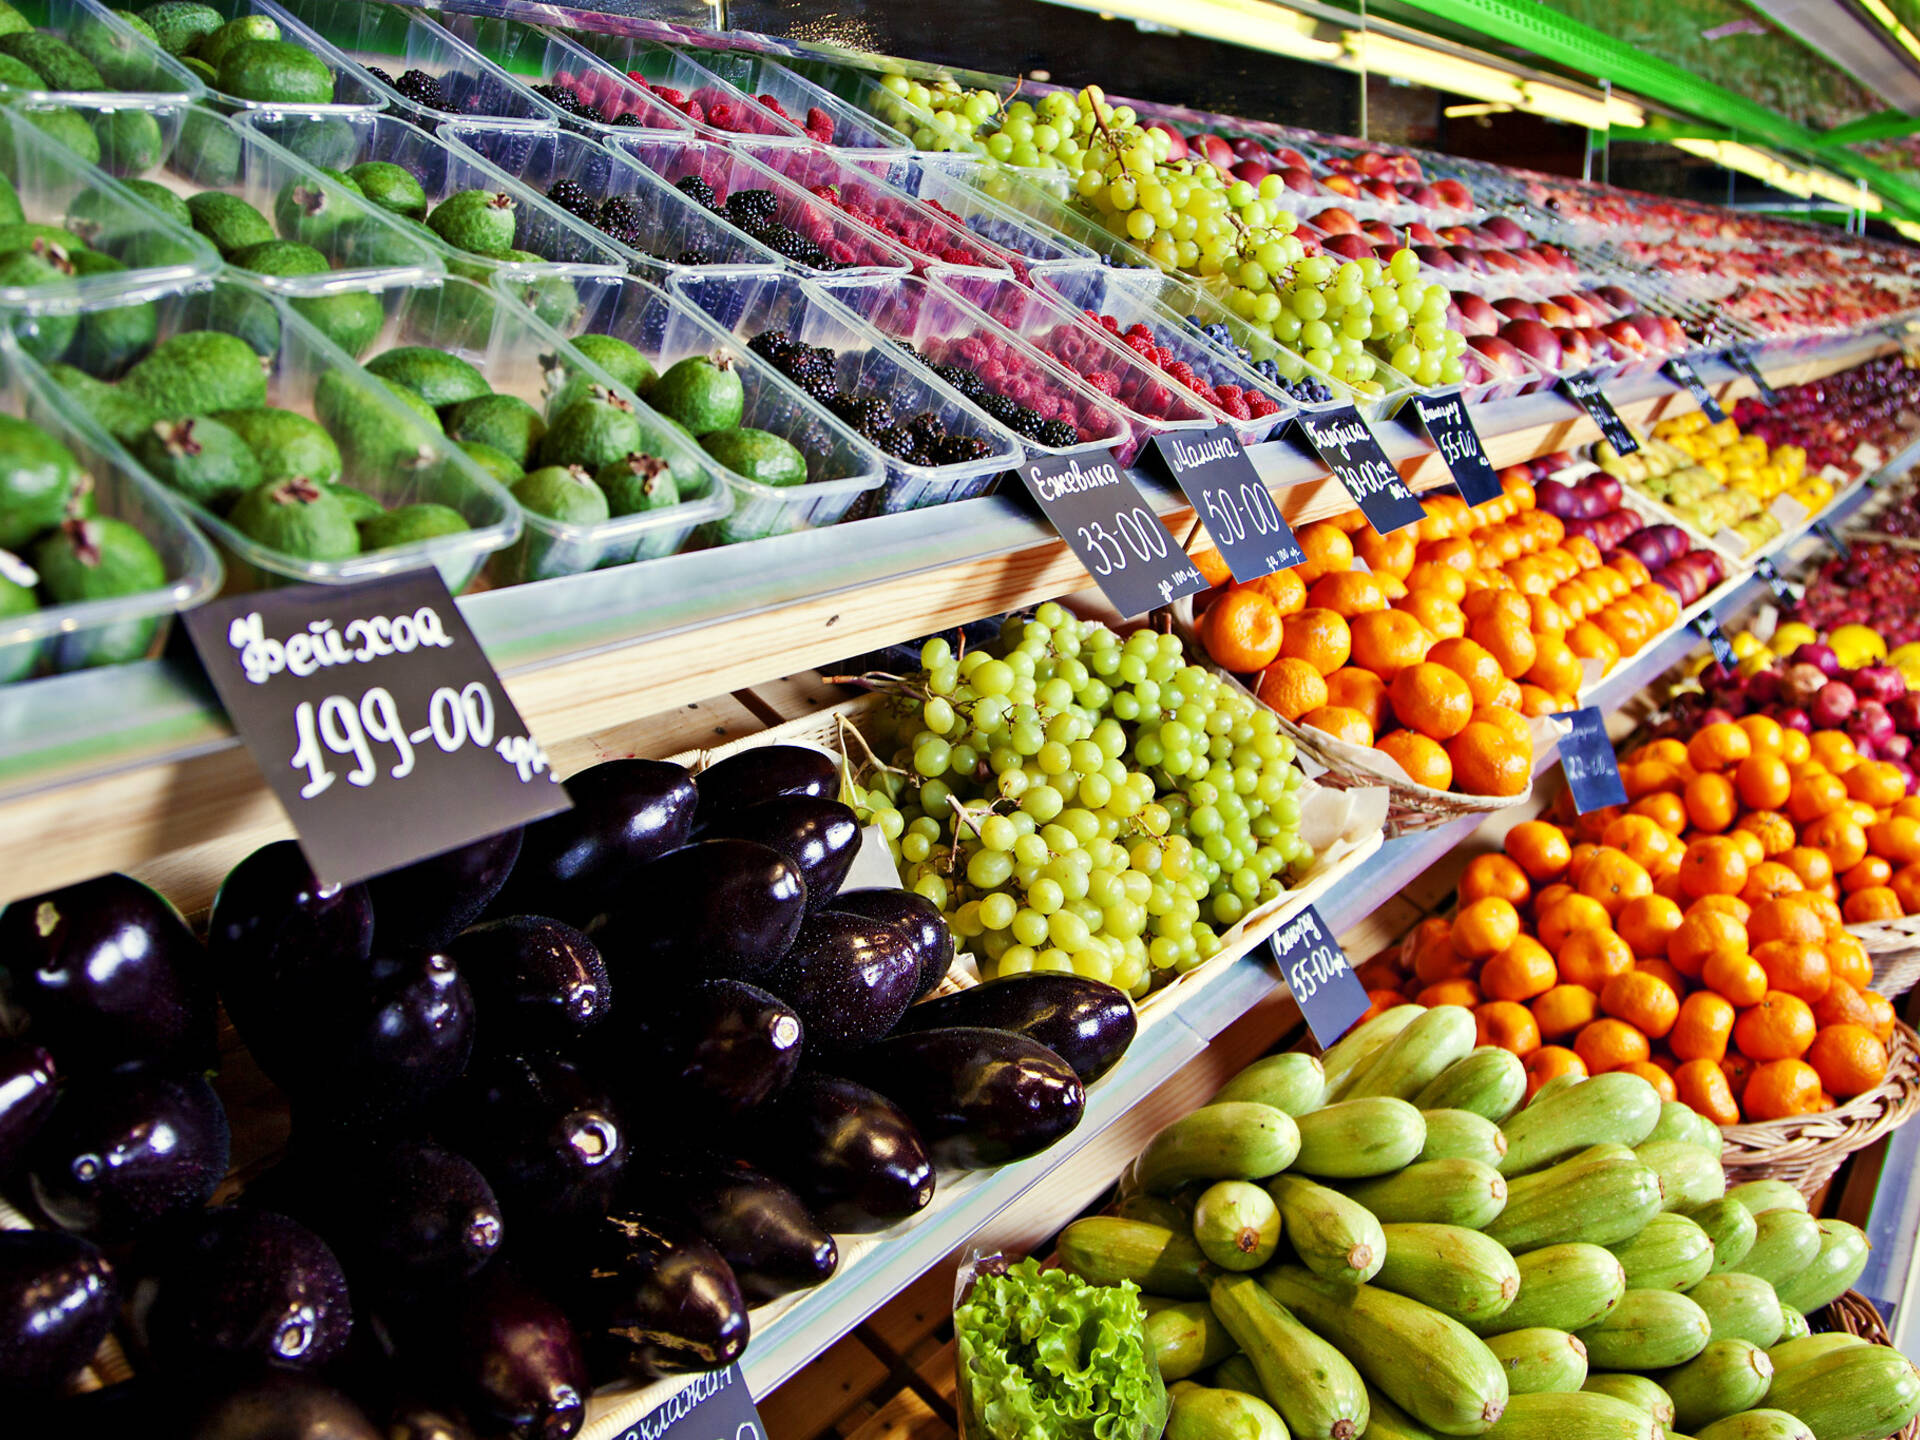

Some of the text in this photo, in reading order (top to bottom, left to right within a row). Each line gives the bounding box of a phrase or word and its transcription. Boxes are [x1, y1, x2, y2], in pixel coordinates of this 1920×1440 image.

[1172, 437, 1240, 473] Малина
[1439, 430, 1477, 465] 55-00
[1030, 459, 1120, 501] Ежевика
[1077, 507, 1168, 575] 33-00
[1202, 482, 1280, 545] 50-00
[228, 606, 454, 684] Фейхоа
[290, 681, 495, 799] 199-00
[1291, 945, 1335, 1003] 55-00
